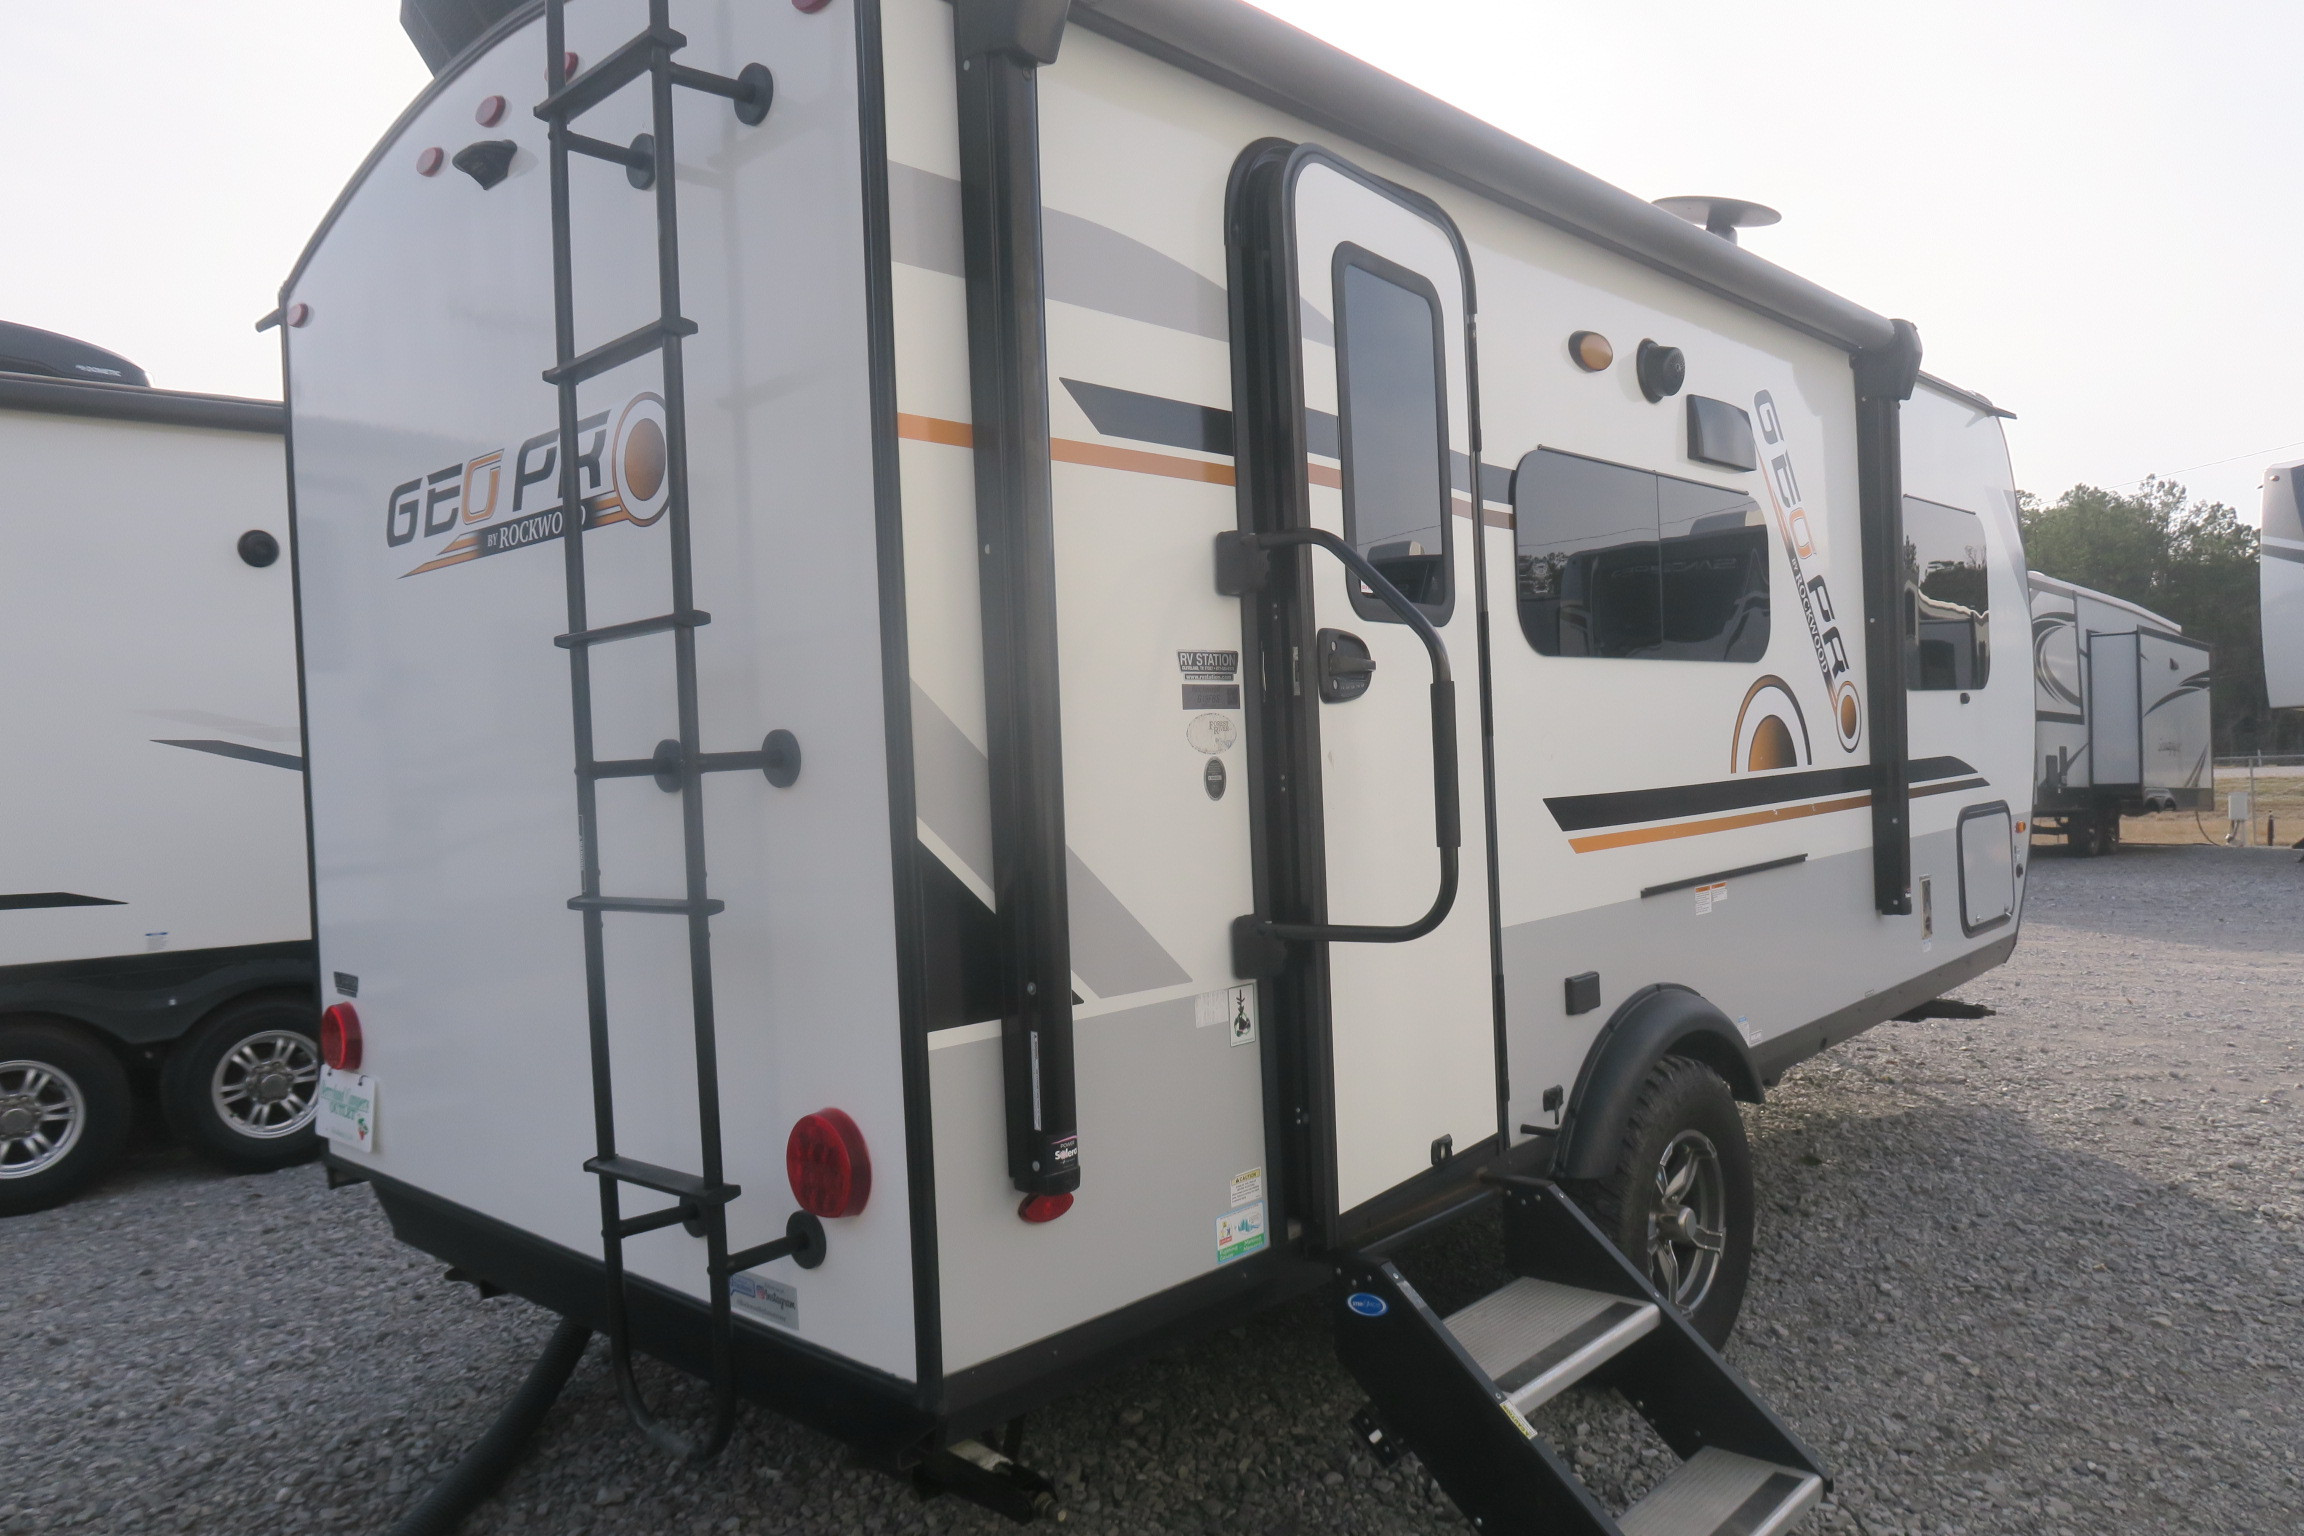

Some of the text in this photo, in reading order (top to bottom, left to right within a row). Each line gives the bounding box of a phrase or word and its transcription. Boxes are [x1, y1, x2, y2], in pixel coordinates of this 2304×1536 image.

[387, 448, 505, 548] GEO
[1753, 389, 1817, 560] GEO
[487, 505, 587, 549] BY ROCKWO
[1791, 558, 1829, 674] BY ROCKWOOD
[1180, 652, 1236, 666] RV STATION
[1239, 1171, 1257, 1182] CAUTION
